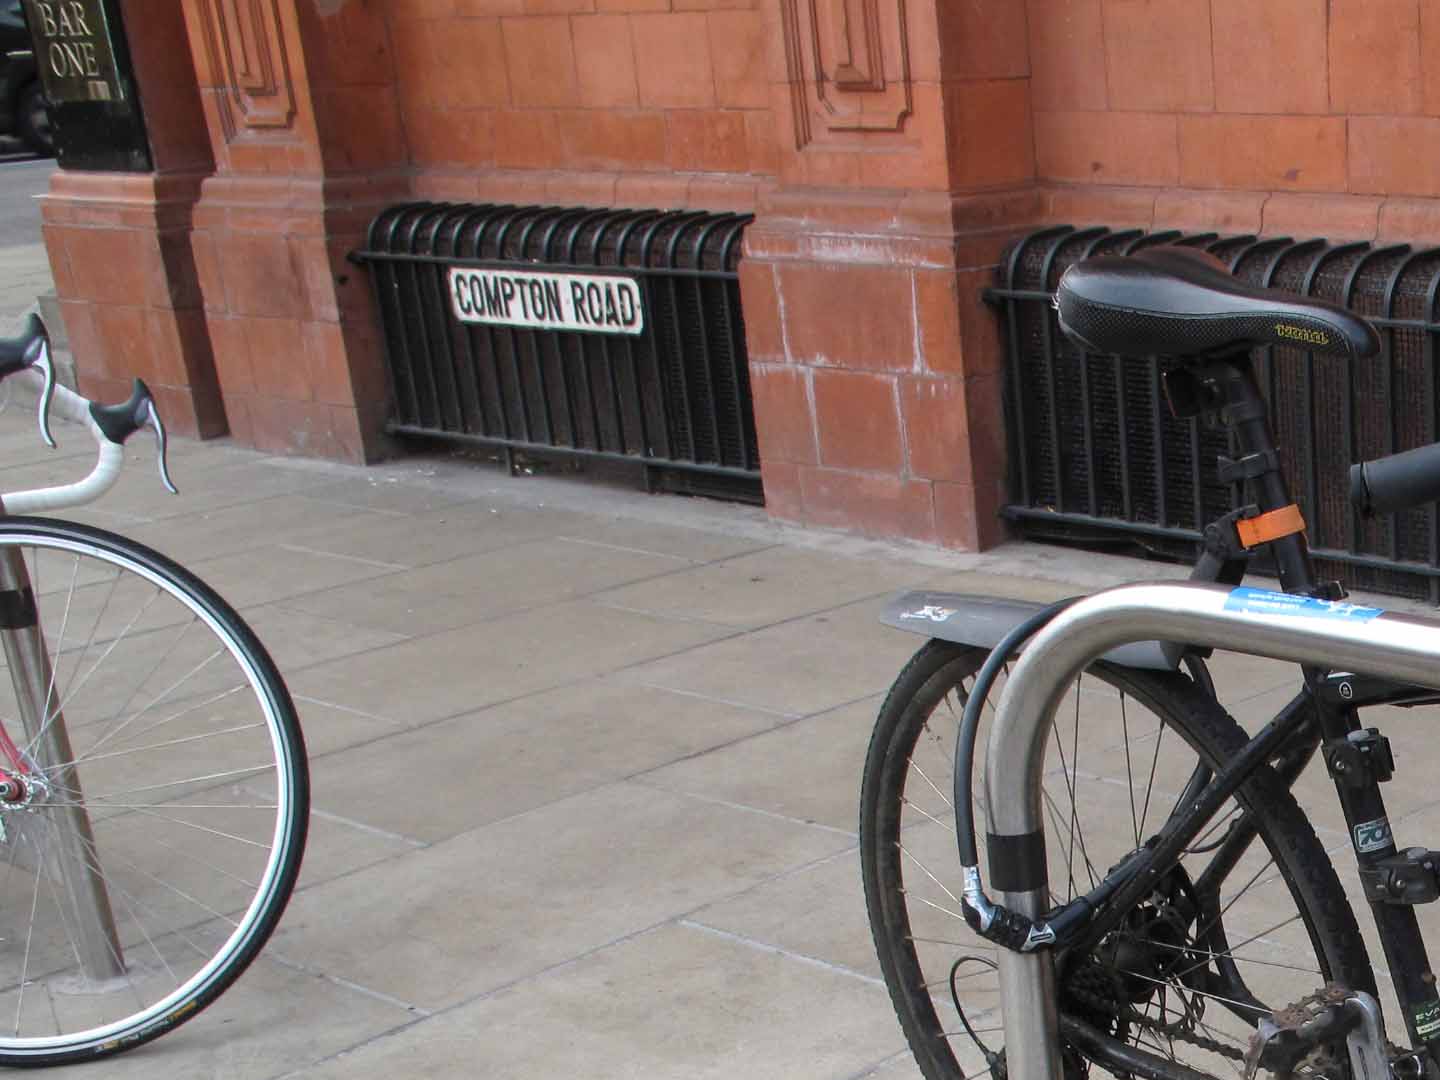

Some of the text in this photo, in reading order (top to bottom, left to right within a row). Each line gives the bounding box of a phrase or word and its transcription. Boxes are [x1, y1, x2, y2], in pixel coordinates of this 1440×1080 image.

[37, 1, 93, 36] BAR
[50, 42, 99, 77] ONE
[455, 274, 636, 328] COMPTON ROAD
